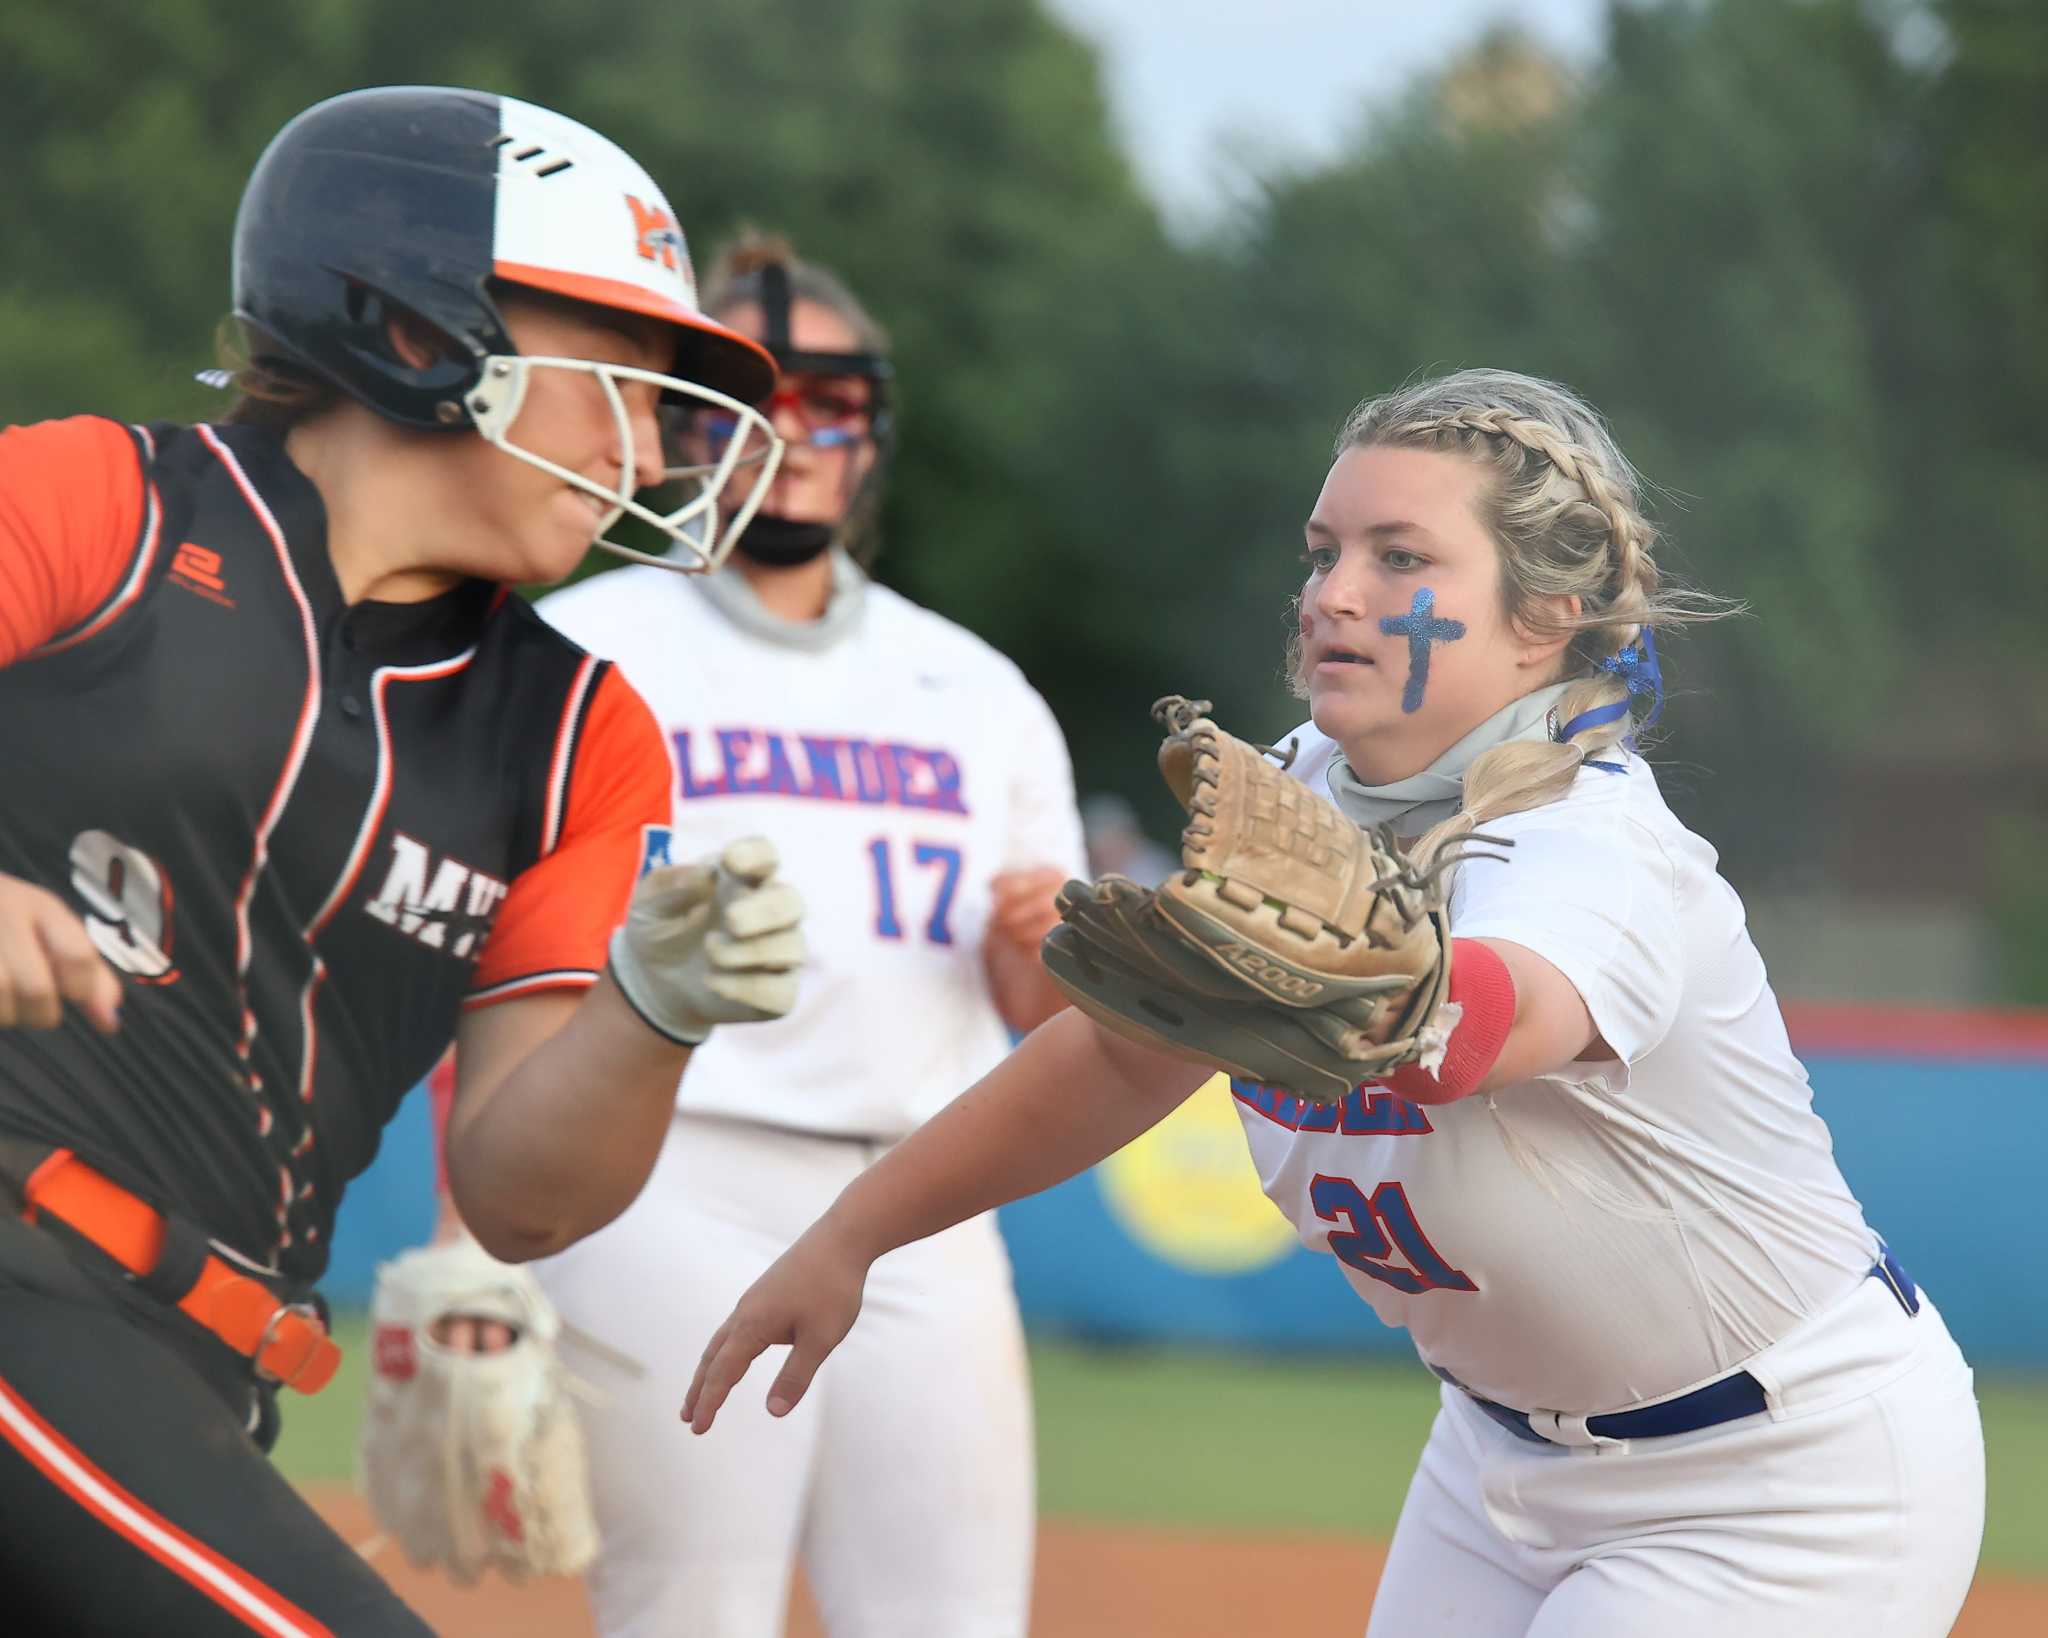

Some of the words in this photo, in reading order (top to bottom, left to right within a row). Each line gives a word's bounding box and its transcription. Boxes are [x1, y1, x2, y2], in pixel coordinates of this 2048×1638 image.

[672, 729, 970, 817] LEANDER
[68, 828, 180, 984] 9
[866, 836, 960, 946] 17
[1214, 943, 1325, 998] A2000
[1309, 1172, 1480, 1294] 21
